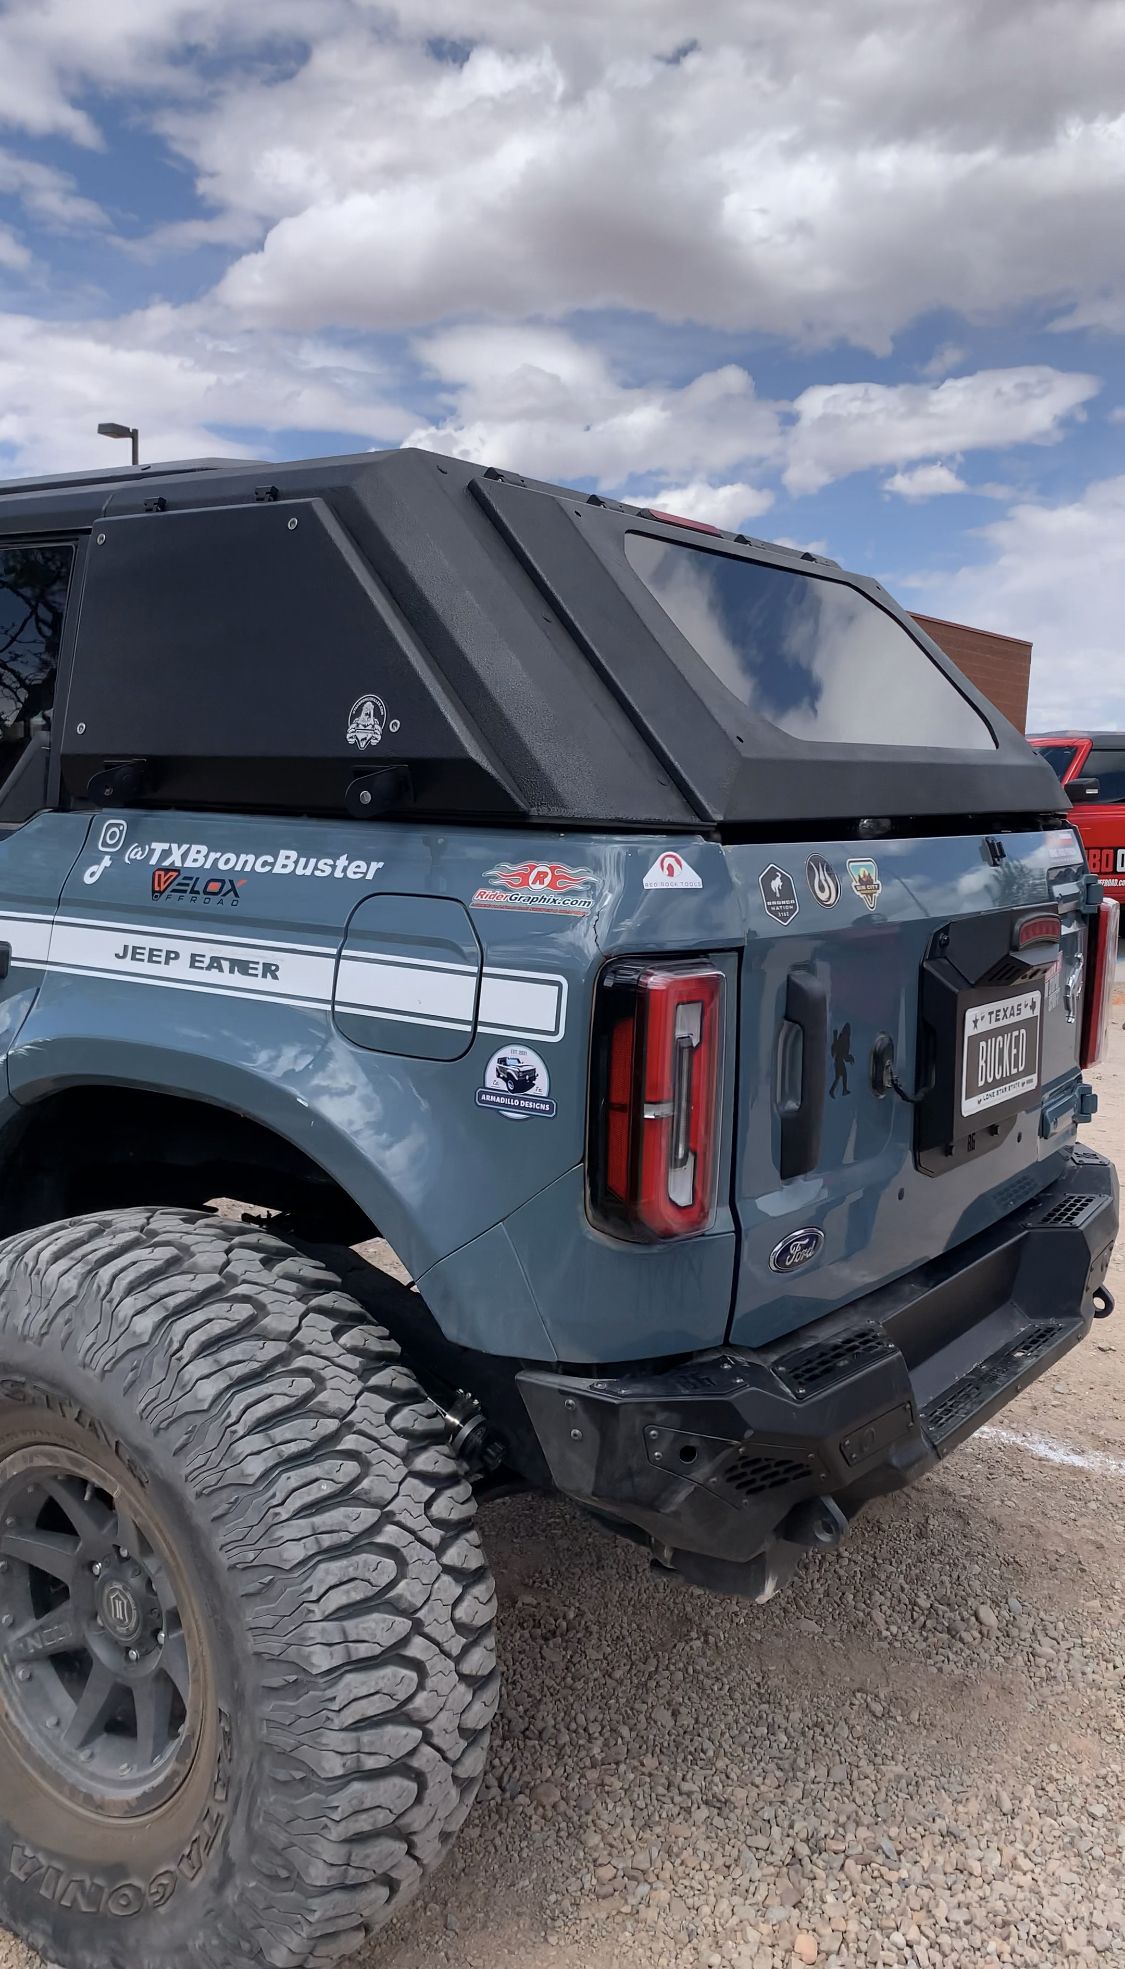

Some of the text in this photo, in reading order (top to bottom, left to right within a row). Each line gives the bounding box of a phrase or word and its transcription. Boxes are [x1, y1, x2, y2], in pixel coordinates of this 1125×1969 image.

[124, 842, 385, 880] @TXBroncBuster
[1086, 849, 1113, 873] BO
[152, 868, 247, 899] VELOX
[531, 870, 549, 886] R
[152, 892, 240, 907] OFFROAD
[475, 889, 592, 908] RiderGraphix.com
[114, 944, 280, 981] JEEP EATER
[987, 1002, 1022, 1025] TEXAS
[977, 1028, 1027, 1088] BUCKED
[481, 1093, 550, 1111] ARMADILLO DESIGNS
[785, 1237, 817, 1266] Ford
